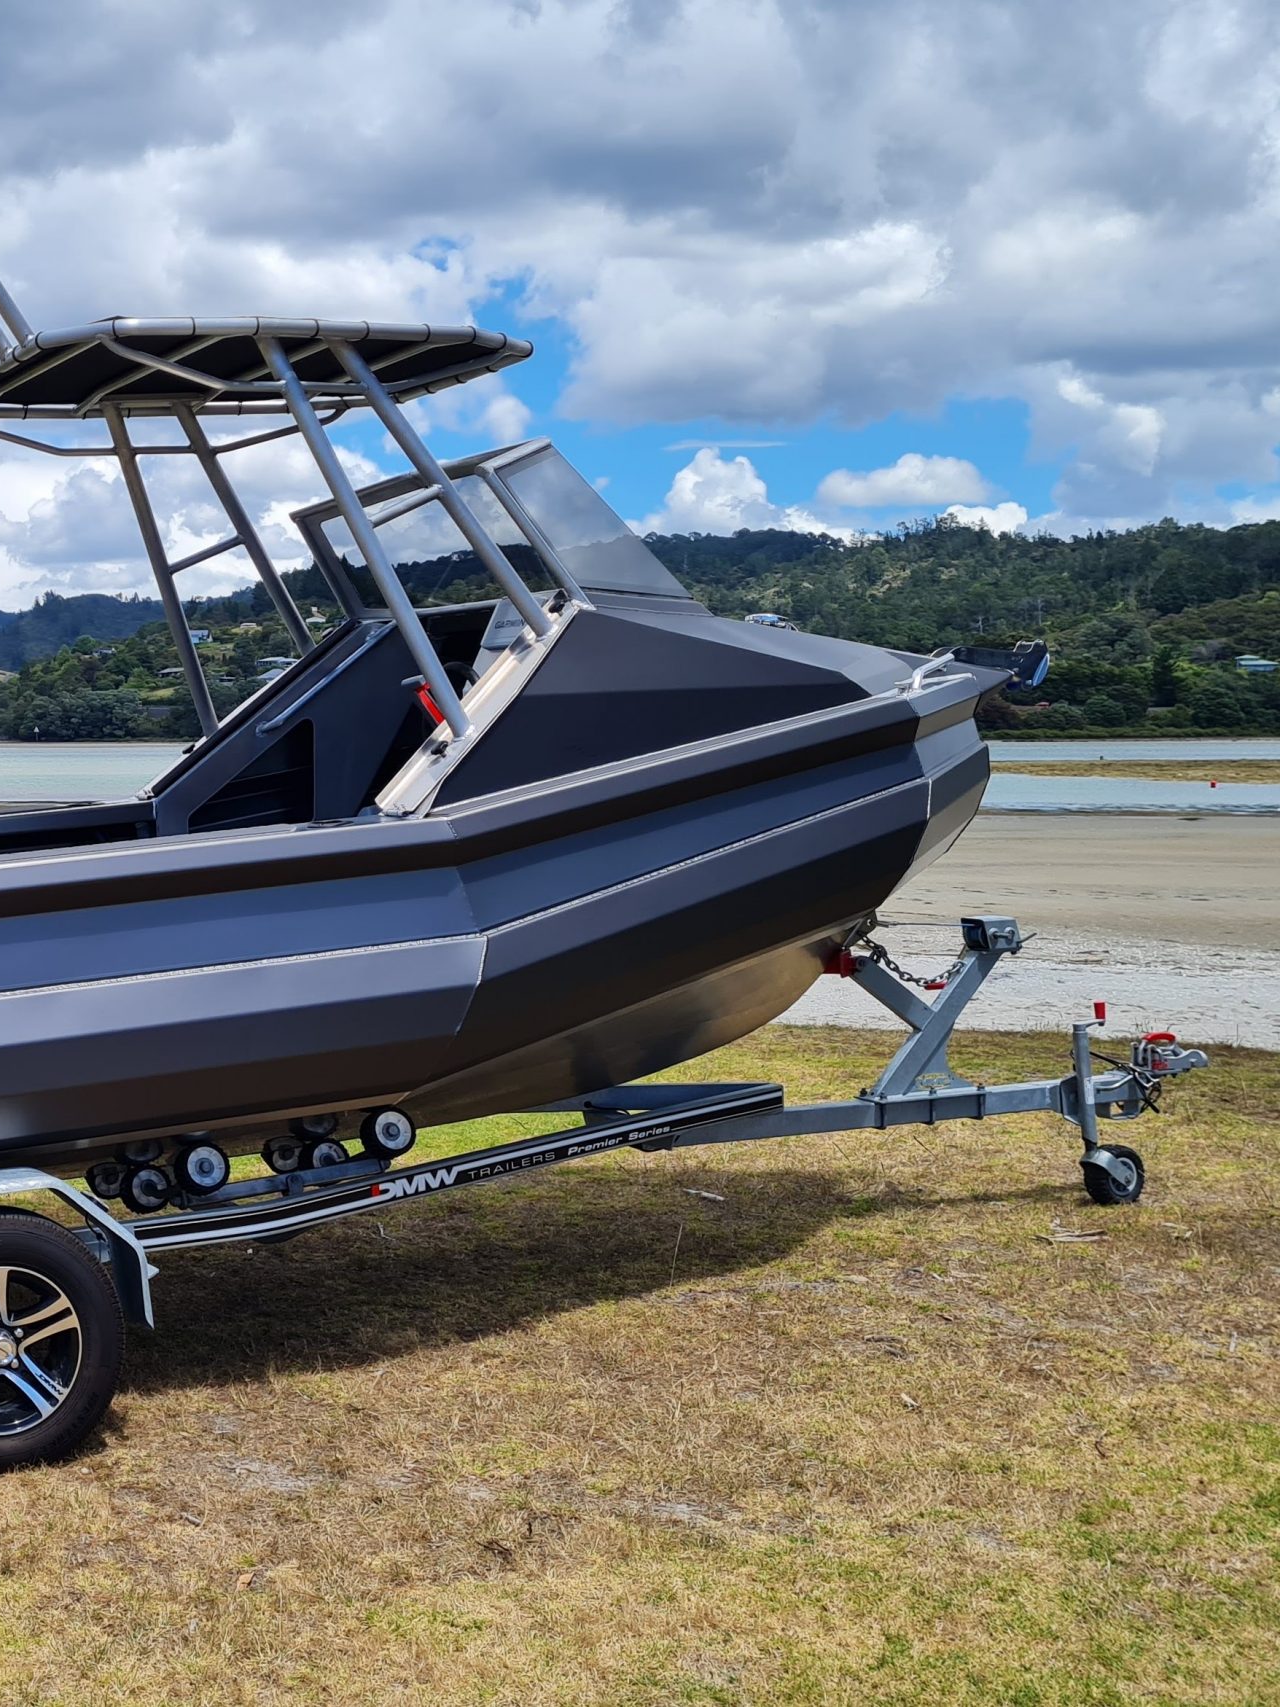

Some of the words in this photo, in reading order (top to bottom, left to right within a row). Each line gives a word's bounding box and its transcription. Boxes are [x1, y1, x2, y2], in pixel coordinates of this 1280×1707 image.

[467, 1151, 556, 1180] TRAILERS
[567, 1136, 623, 1156] Premier
[628, 1125, 671, 1141] Series
